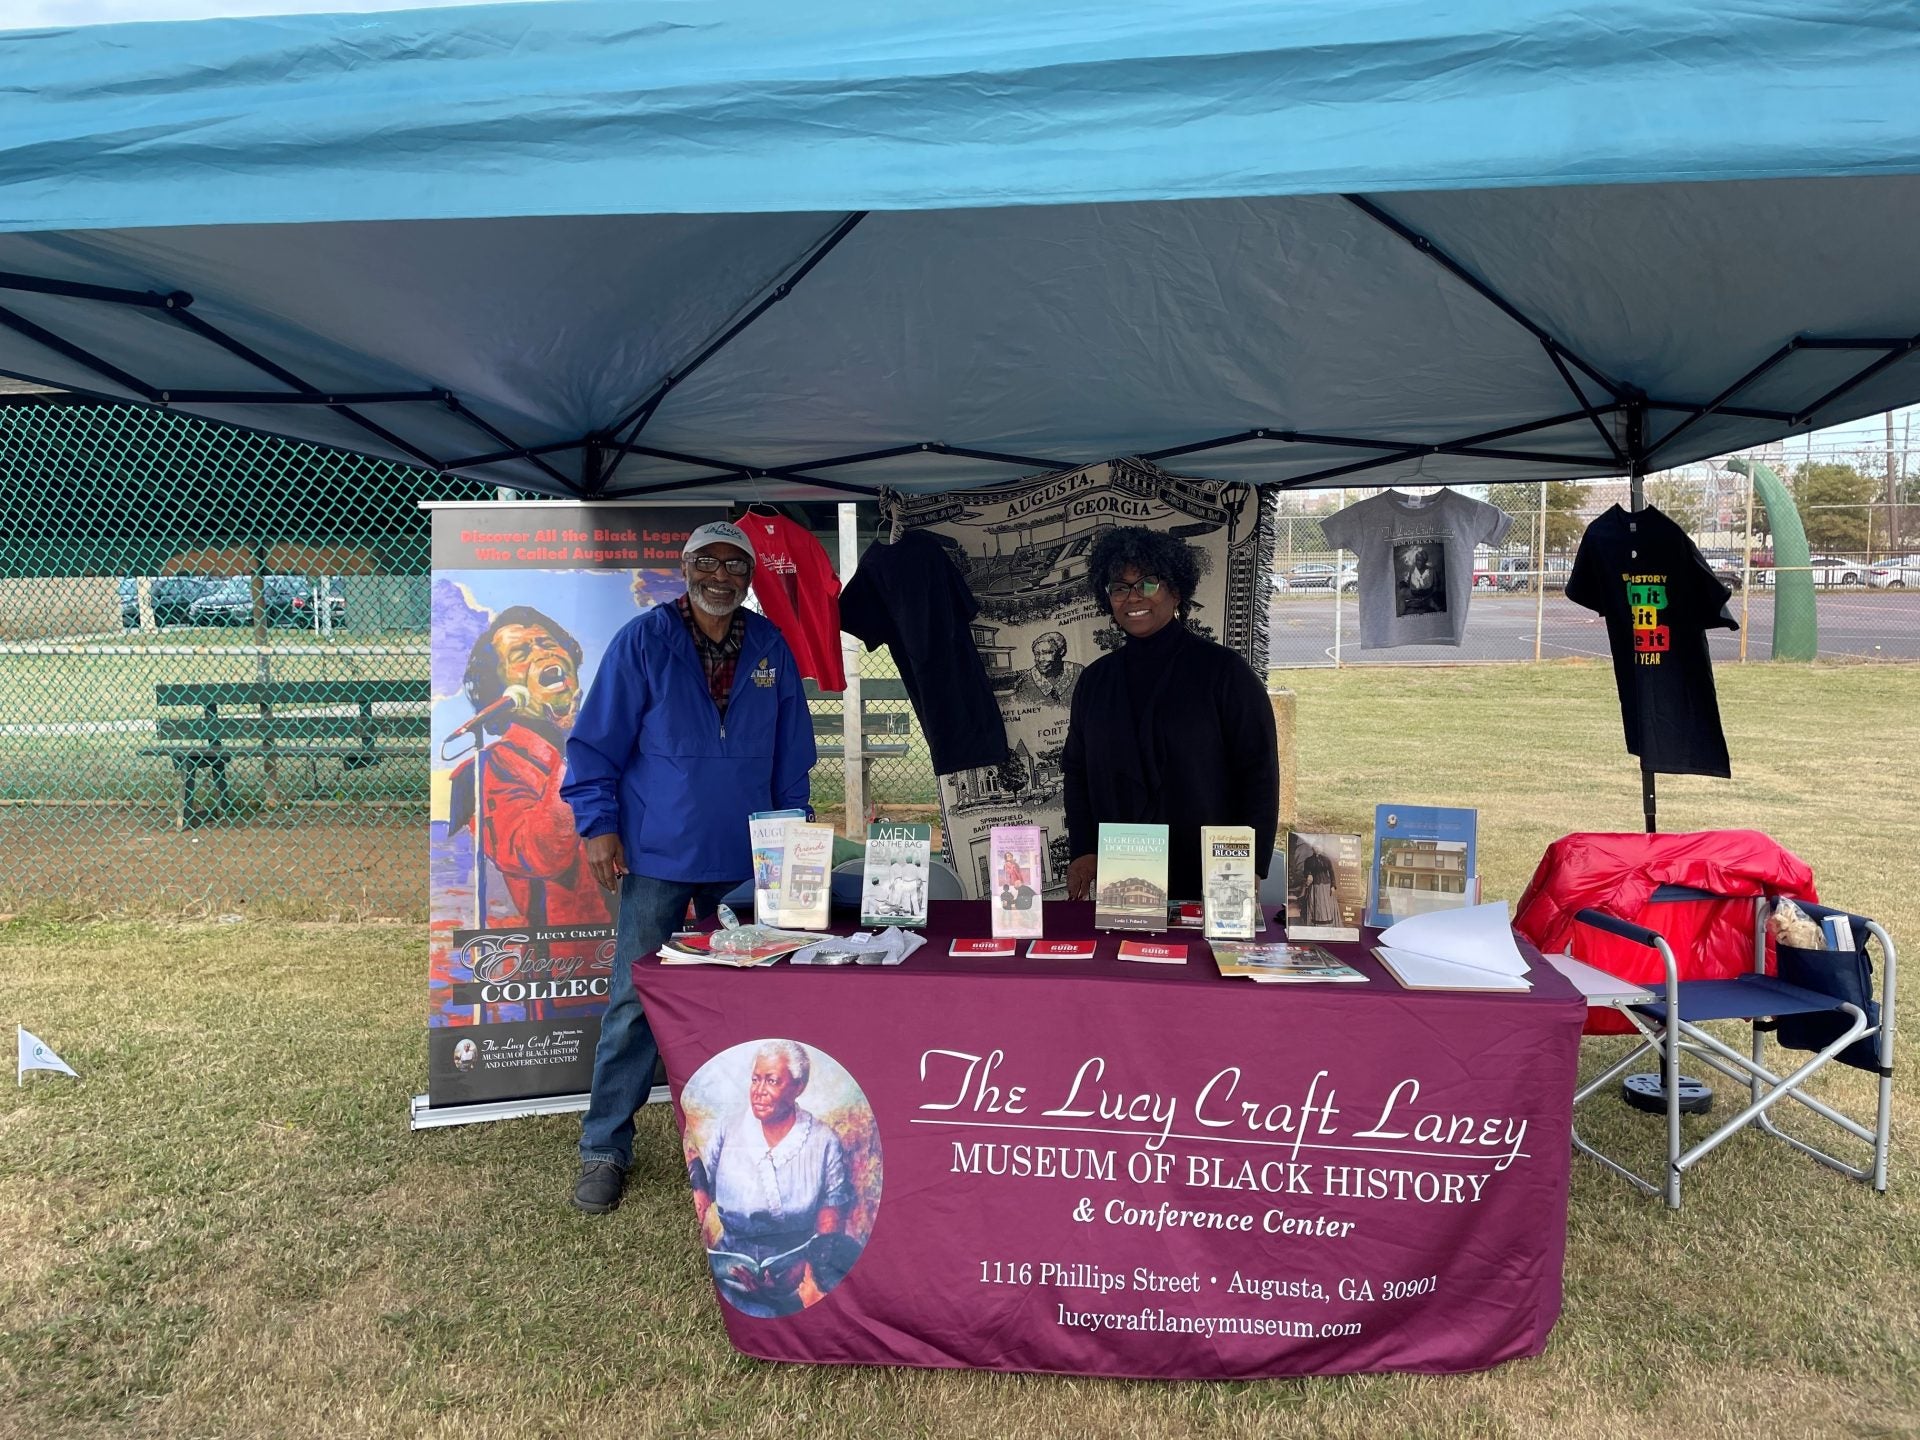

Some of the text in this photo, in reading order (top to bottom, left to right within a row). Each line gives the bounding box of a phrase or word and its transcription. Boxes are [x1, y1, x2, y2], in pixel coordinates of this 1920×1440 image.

[1007, 473, 1095, 517] AUGUSTA,
[1073, 496, 1151, 516] GEORGIA
[460, 528, 691, 546] Discover All the Black Legen
[475, 548, 511, 561] Who
[517, 547, 568, 560] Called
[572, 547, 638, 562] Augusta
[1631, 574, 1667, 583] ISTORY
[1647, 586, 1661, 605] it
[1054, 603, 1100, 620] JESSYE NOR
[1638, 609, 1653, 625] it
[1650, 629, 1665, 647] it
[1640, 652, 1661, 665] YEAR
[1001, 706, 1042, 717] AFT LANEY
[1037, 726, 1064, 738] FORT
[979, 813, 1023, 824] SPRINGFIELD
[1003, 819, 1034, 828] CHURCH
[878, 827, 916, 841] MEN
[1103, 836, 1165, 846] SEGREGATED
[887, 840, 903, 848] THE
[905, 841, 923, 849] BAG
[1105, 844, 1163, 853] DOCTORING
[1214, 849, 1248, 857] BLOCKS
[536, 931, 567, 940] LUCY
[570, 929, 607, 939] CRAFT
[460, 934, 584, 985] Ebony
[480, 977, 609, 1003] COLLEC
[481, 1035, 580, 1051] The Lucy Craft Laney
[482, 1046, 580, 1061] MUSEUM OF BLACK HISTORY
[485, 1055, 578, 1069] AND CONFERENCE CENTER
[919, 1049, 1528, 1172] The Lucy Craft Laney
[950, 1142, 1490, 1204] MUSEUM OF BLACK HISTORY
[1072, 1198, 1355, 1238] & Conference Center
[979, 1260, 1438, 1303] 1116 Phillips Street Augusta, GA 30901
[1056, 1303, 1363, 1339] lucycraftlaneymuseum.com
